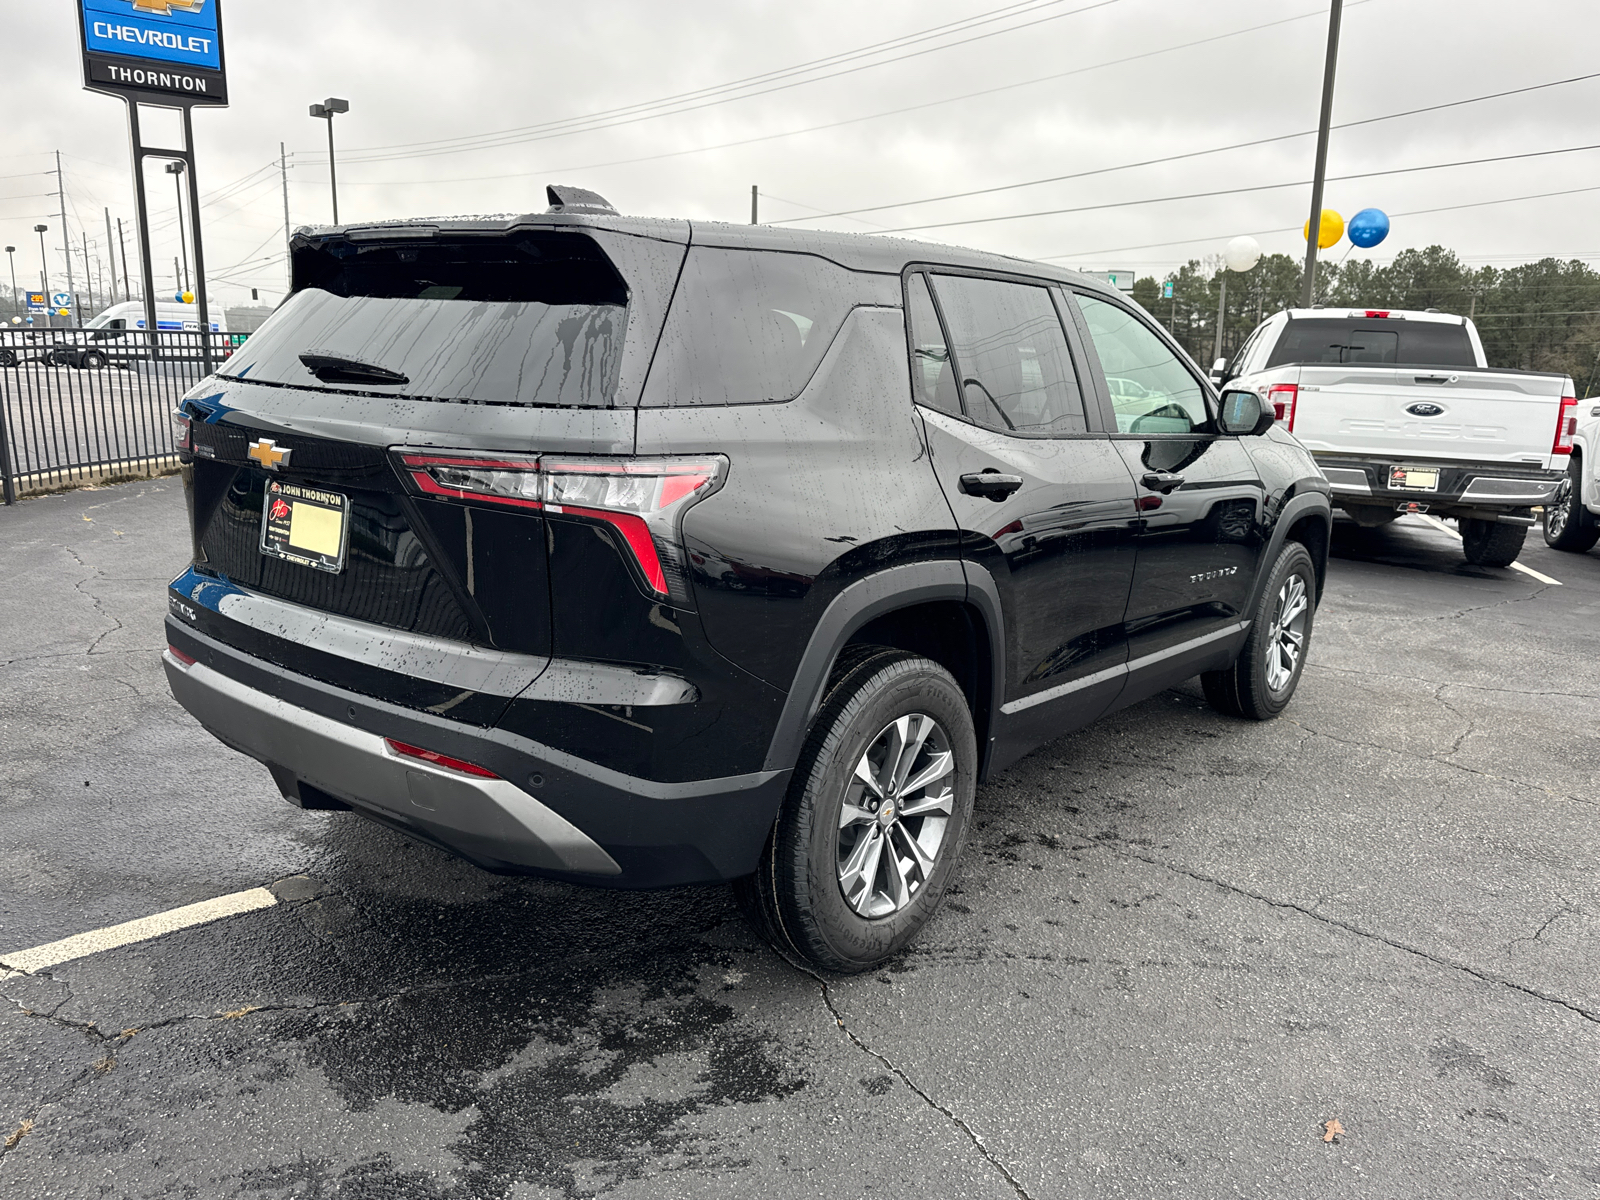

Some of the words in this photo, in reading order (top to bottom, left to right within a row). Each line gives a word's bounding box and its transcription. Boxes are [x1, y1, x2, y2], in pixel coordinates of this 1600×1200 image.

[94, 22, 211, 53] CHEVROLET
[108, 65, 206, 92] THORNTON
[1414, 404, 1437, 414] Ford
[282, 484, 301, 497] JOHN
[302, 488, 341, 506] THORNTON
